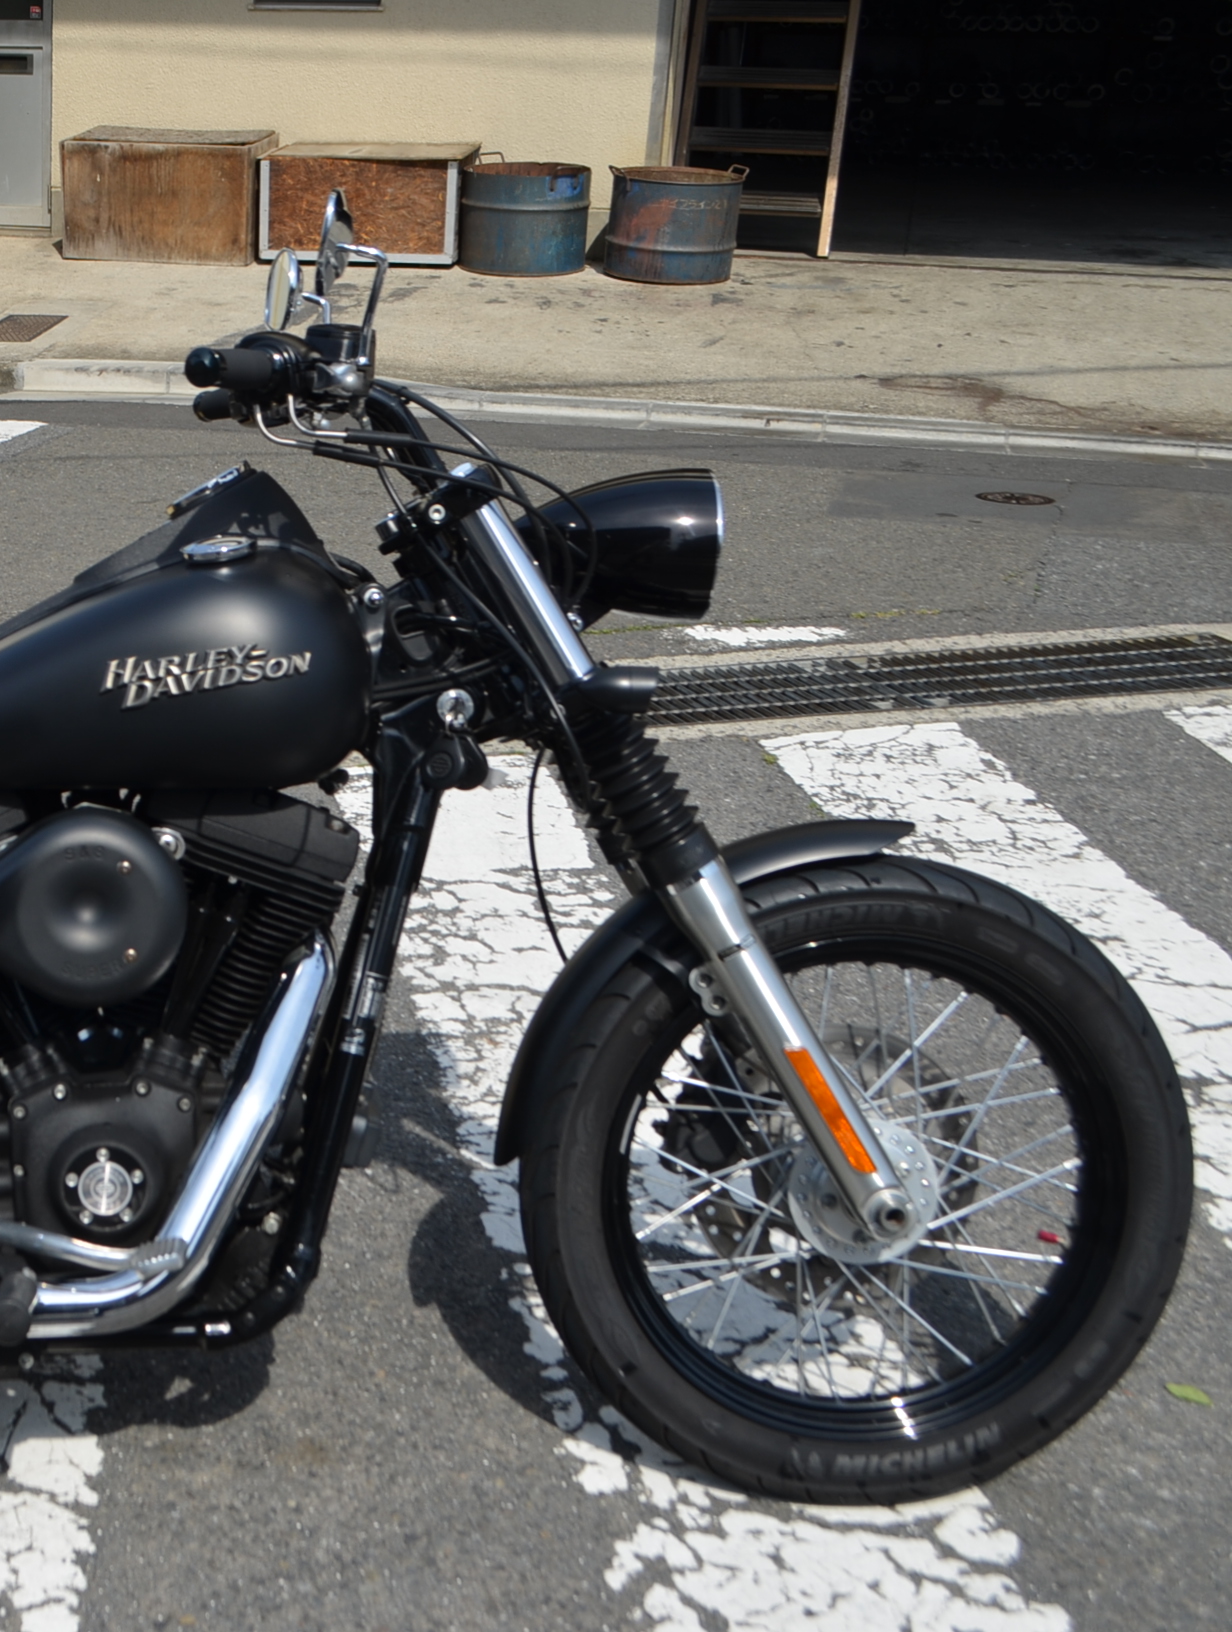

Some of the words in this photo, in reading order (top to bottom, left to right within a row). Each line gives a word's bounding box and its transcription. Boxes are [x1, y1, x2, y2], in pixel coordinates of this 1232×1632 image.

[101, 643, 268, 693] HARLEY-
[121, 652, 311, 709] DAVIDSON
[833, 1422, 1000, 1476] MICHELIN
